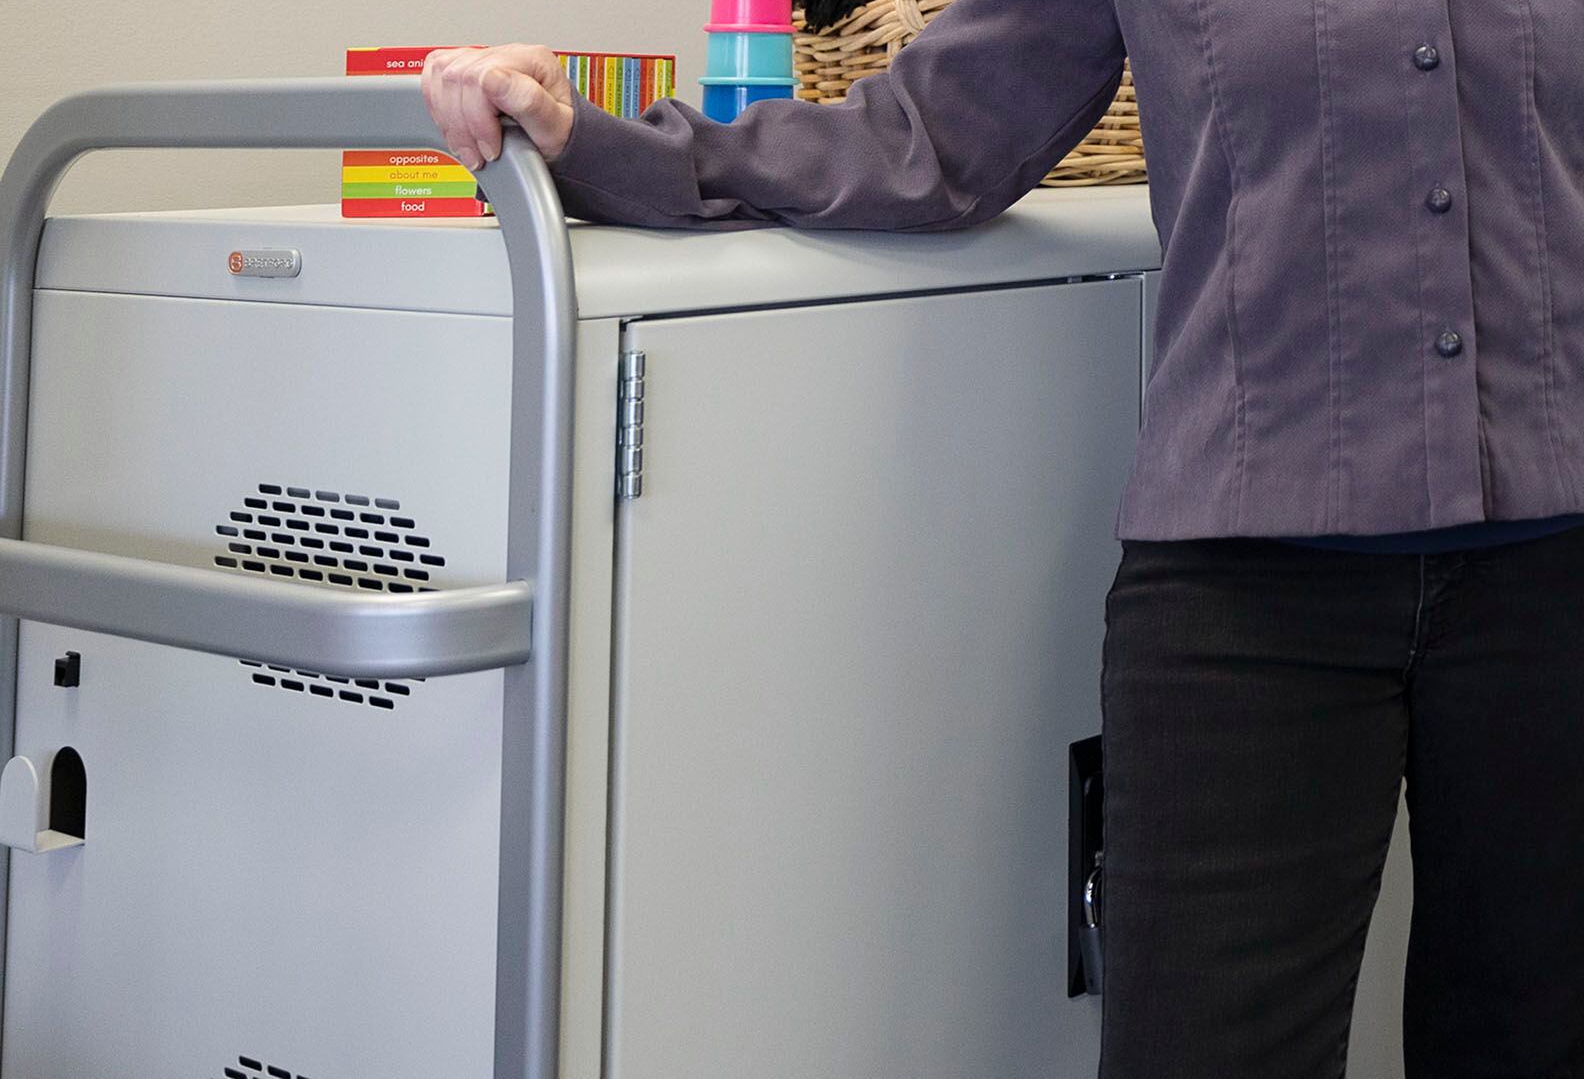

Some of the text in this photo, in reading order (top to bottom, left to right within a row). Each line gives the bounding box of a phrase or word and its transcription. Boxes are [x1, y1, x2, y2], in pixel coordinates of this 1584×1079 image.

[386, 58, 425, 68] sea ani
[389, 154, 439, 166] opposites
[389, 170, 438, 180] about me
[395, 185, 432, 195] flowers
[401, 201, 425, 212] food
